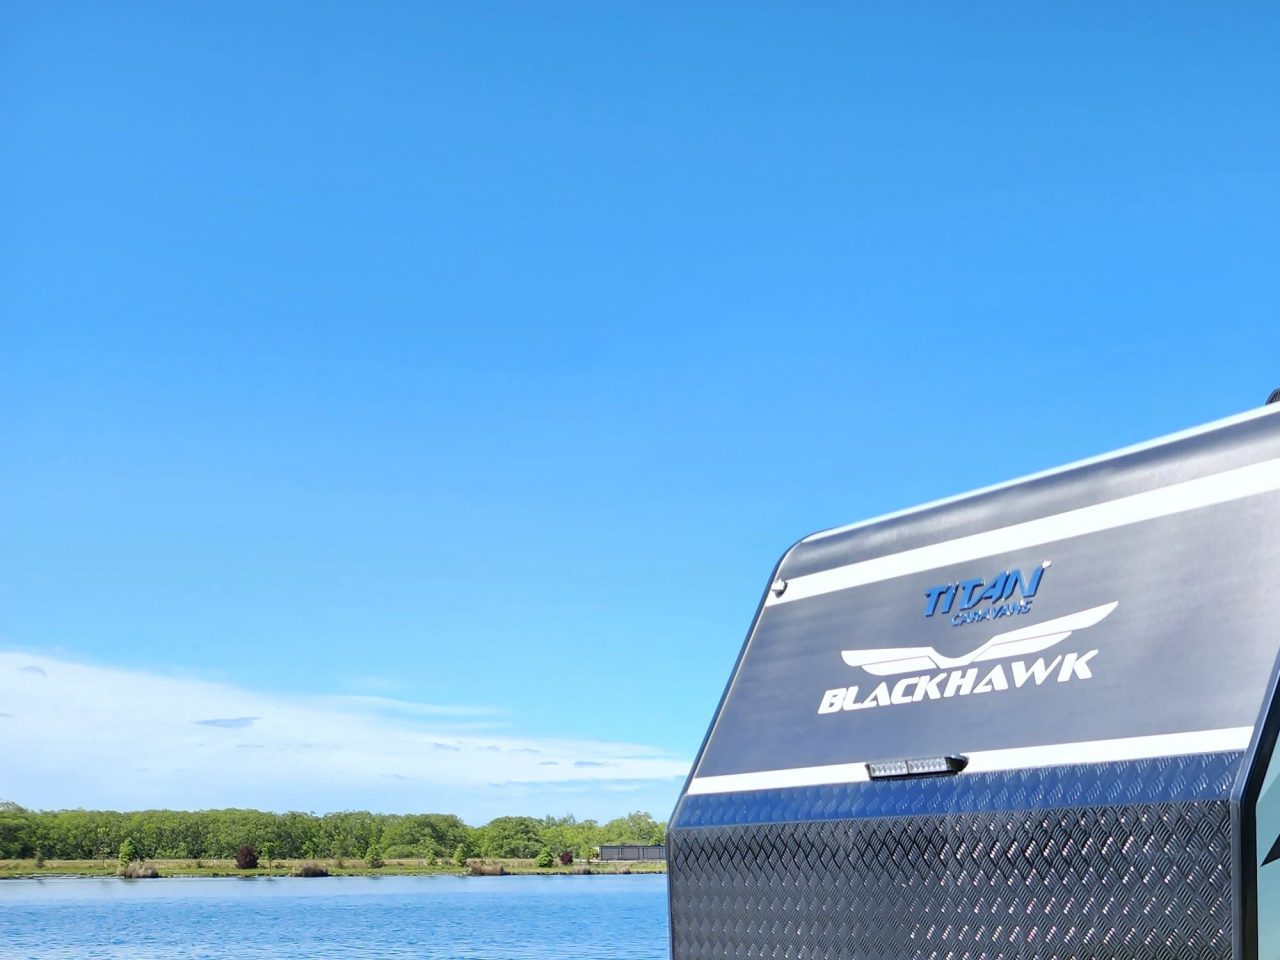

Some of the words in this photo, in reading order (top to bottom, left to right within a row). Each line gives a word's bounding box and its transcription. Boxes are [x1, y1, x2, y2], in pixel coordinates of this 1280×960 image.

[924, 566, 1045, 617] TITAN
[951, 600, 1033, 627] CARAVANS
[817, 649, 1099, 714] BLACKHAWK
